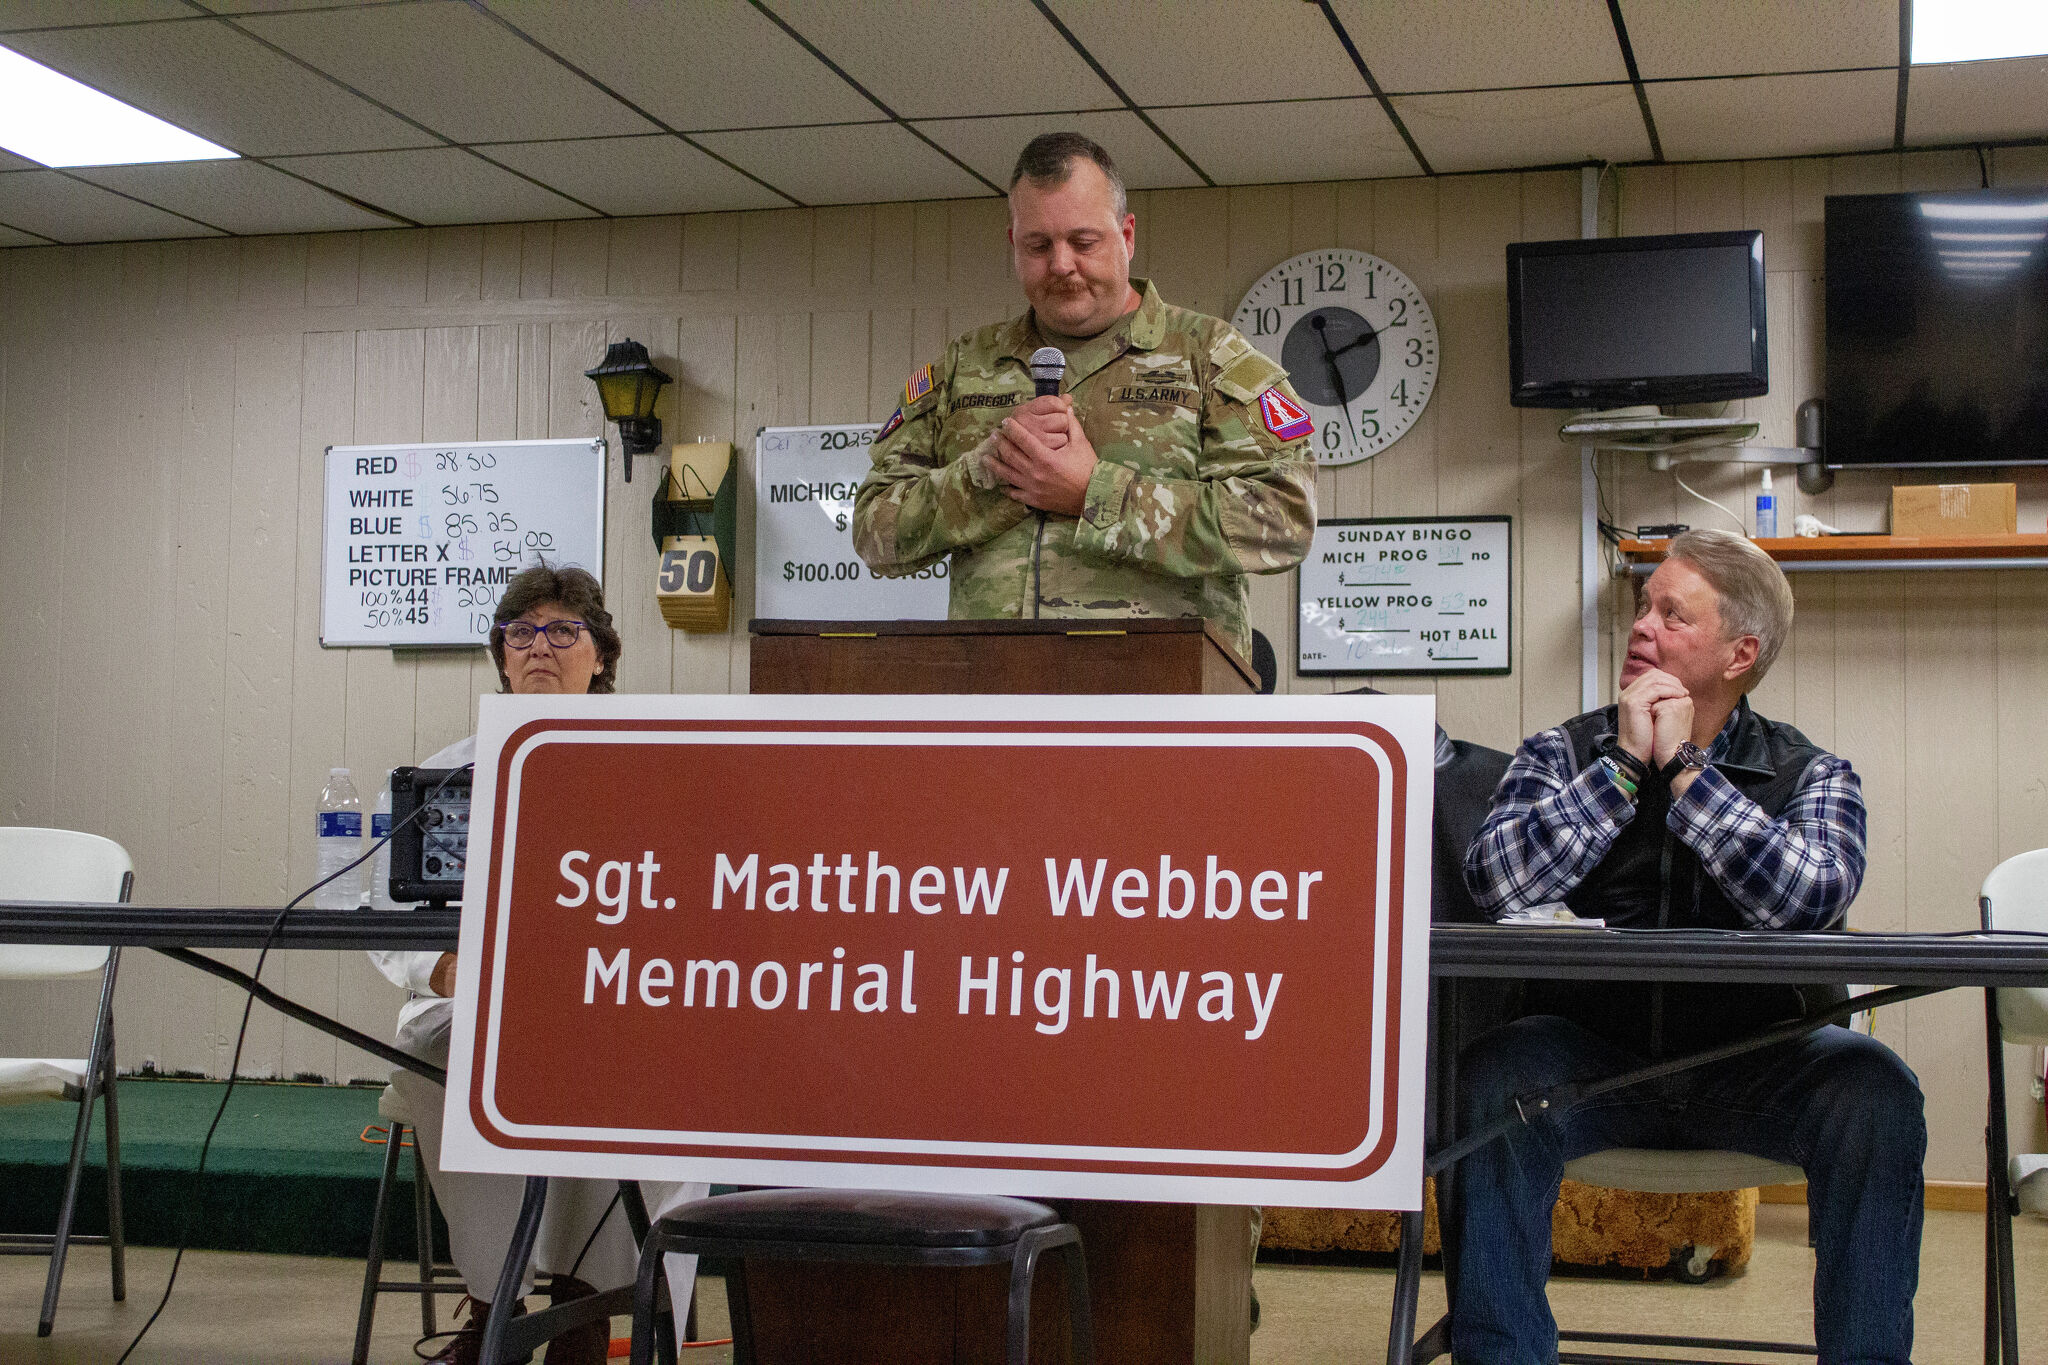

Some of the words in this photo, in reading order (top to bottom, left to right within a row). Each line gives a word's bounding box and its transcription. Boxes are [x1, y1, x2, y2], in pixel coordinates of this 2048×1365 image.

[1315, 263, 1346, 293] 12
[1364, 271, 1377, 299] 1
[1280, 277, 1305, 306] 11
[1253, 307, 1281, 336] 10
[1389, 298, 1408, 327] 2
[1405, 338, 1423, 367] 3
[1390, 379, 1408, 407] 4
[1323, 421, 1340, 450] 6
[1361, 409, 1380, 438] 5
[356, 456, 397, 475] RED
[436, 452, 497, 472] 28.50
[350, 489, 414, 508] WHITE
[442, 484, 499, 505] 56.75
[771, 482, 858, 503] MICHIGA
[350, 517, 402, 535] BLUE
[445, 512, 518, 538] 85.25
[835, 511, 847, 532] $
[1338, 530, 1405, 543] SUNDAY
[1412, 529, 1472, 541] BINGO
[349, 544, 428, 563] LETTER
[437, 543, 450, 562] X
[1322, 552, 1365, 564] MICH
[1379, 550, 1428, 561] PROG
[1471, 552, 1490, 560] no
[349, 568, 437, 587] PICTURE
[445, 566, 517, 586] FRAME
[659, 550, 717, 593] 50
[783, 560, 860, 582] $100.00
[1338, 572, 1345, 586] $
[1317, 596, 1379, 608] YELLOW
[1387, 596, 1433, 607] PROG
[1469, 598, 1487, 607] no
[1338, 617, 1345, 630] $
[1420, 630, 1451, 642] HOT
[1458, 628, 1497, 640] BALL
[1427, 648, 1434, 659] $
[555, 850, 677, 925] Sgt.
[711, 851, 1010, 915] Matthew
[1044, 855, 1323, 920] Webber
[583, 947, 917, 1014] Memorial
[958, 951, 1284, 1041] Highway
